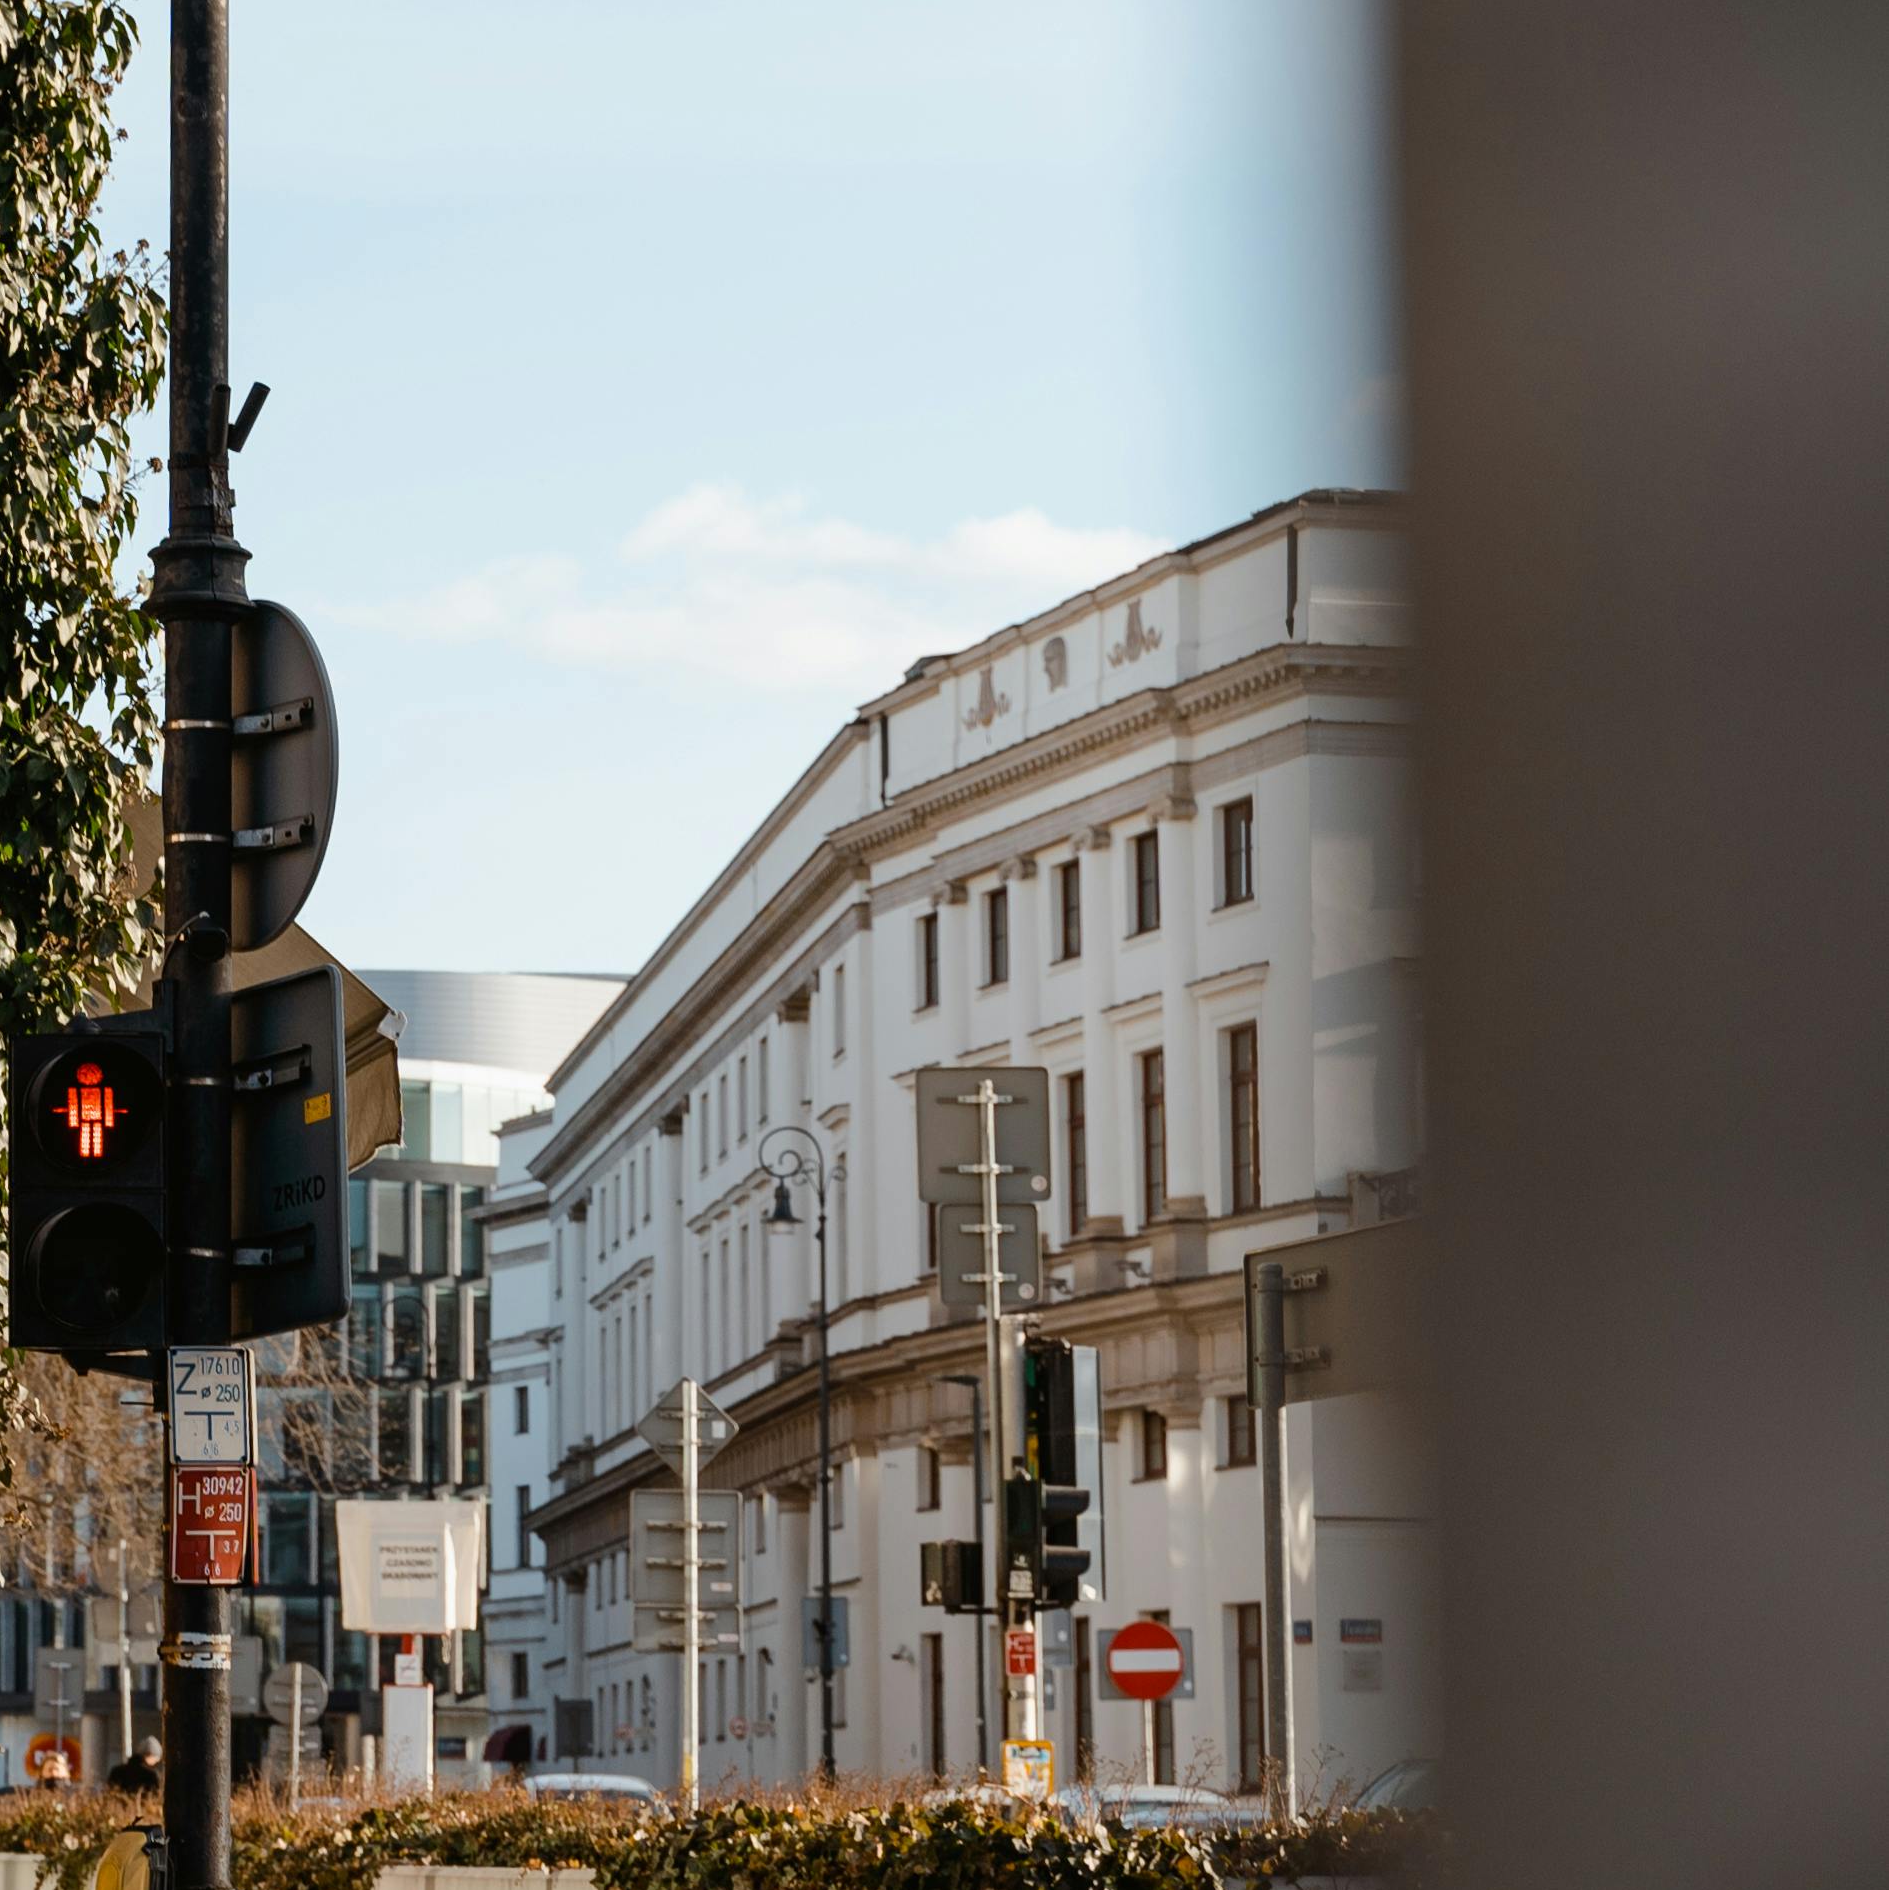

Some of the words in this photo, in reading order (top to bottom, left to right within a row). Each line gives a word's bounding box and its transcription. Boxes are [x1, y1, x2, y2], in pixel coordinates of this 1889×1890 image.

[271, 1174, 326, 1212] ZRiKD
[175, 1363, 197, 1395] Z
[200, 1357, 240, 1376] 17610
[215, 1384, 240, 1402] 250
[178, 1482, 201, 1515] H
[202, 1477, 243, 1495] 30942
[218, 1502, 242, 1522] 250
